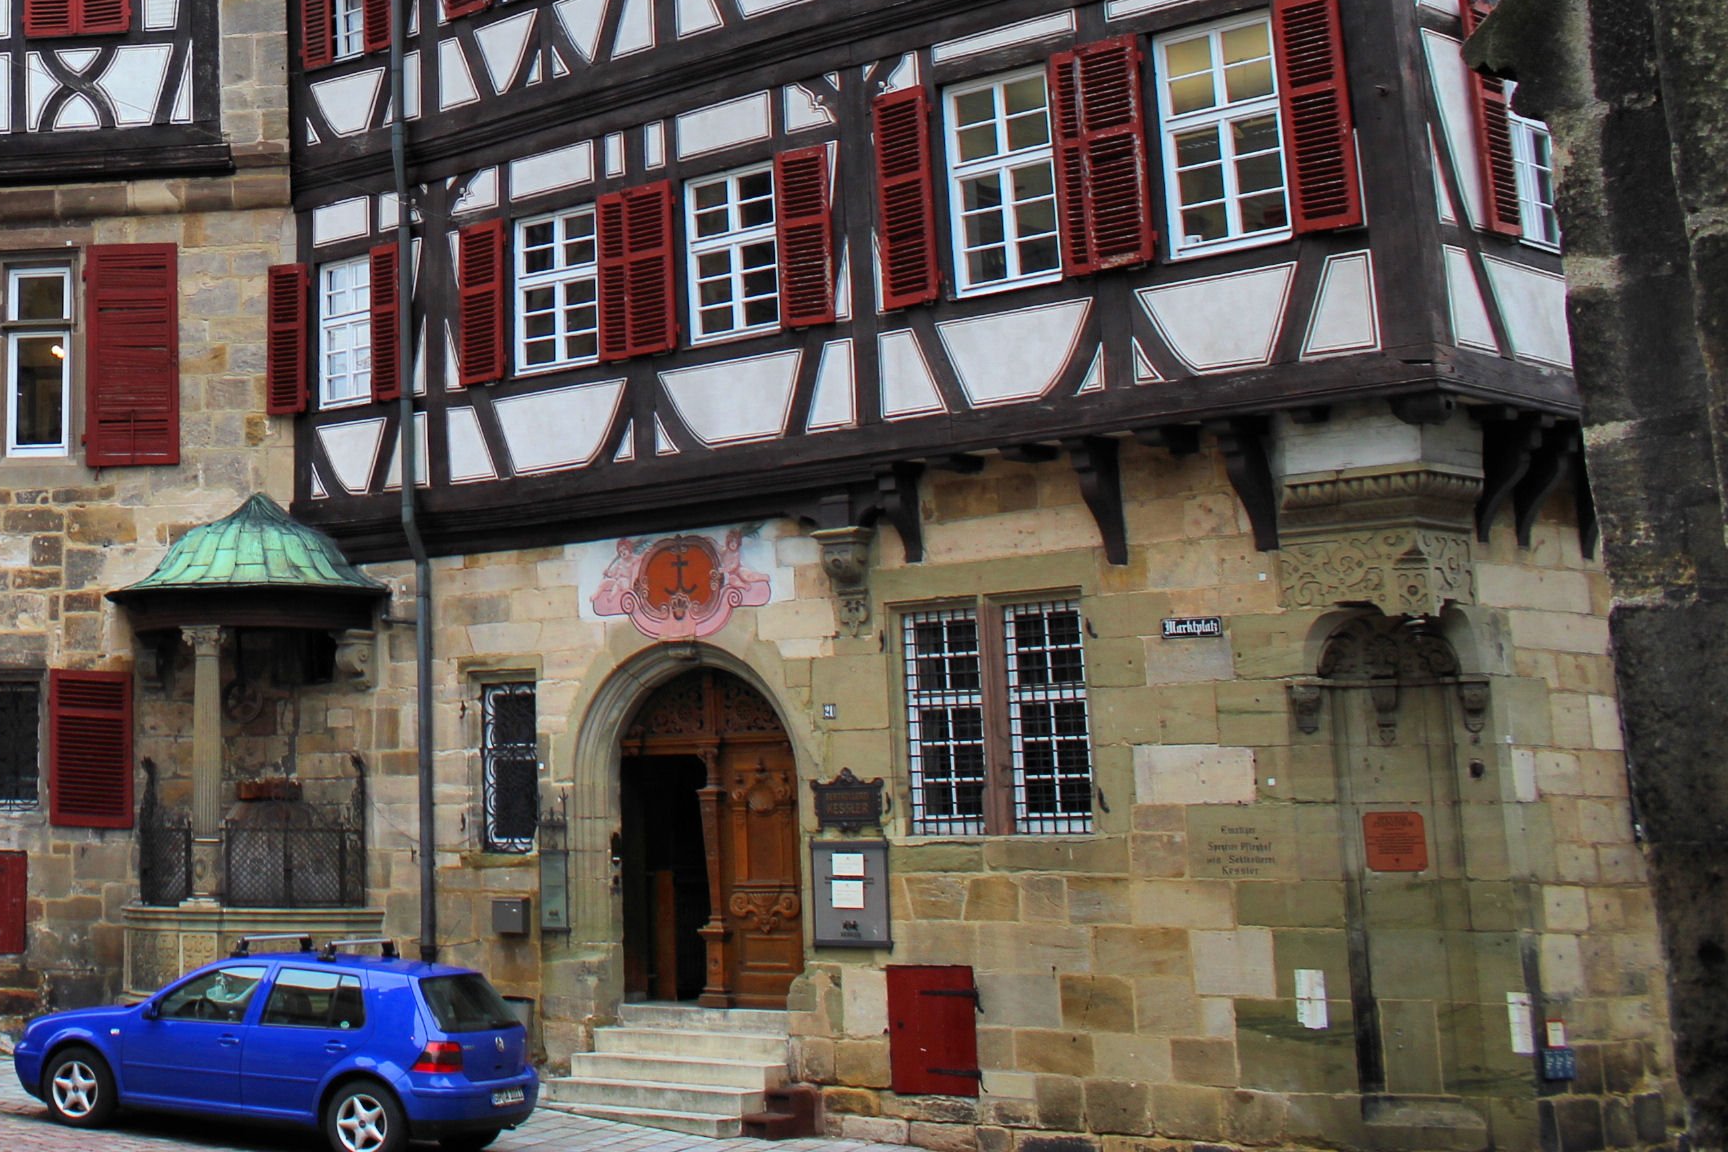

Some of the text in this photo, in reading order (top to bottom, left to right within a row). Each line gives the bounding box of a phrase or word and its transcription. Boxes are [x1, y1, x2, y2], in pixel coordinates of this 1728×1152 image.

[1164, 619, 1218, 635] Marktplatz
[824, 802, 869, 814] KESSLER
[1222, 866, 1259, 875] Kessler
